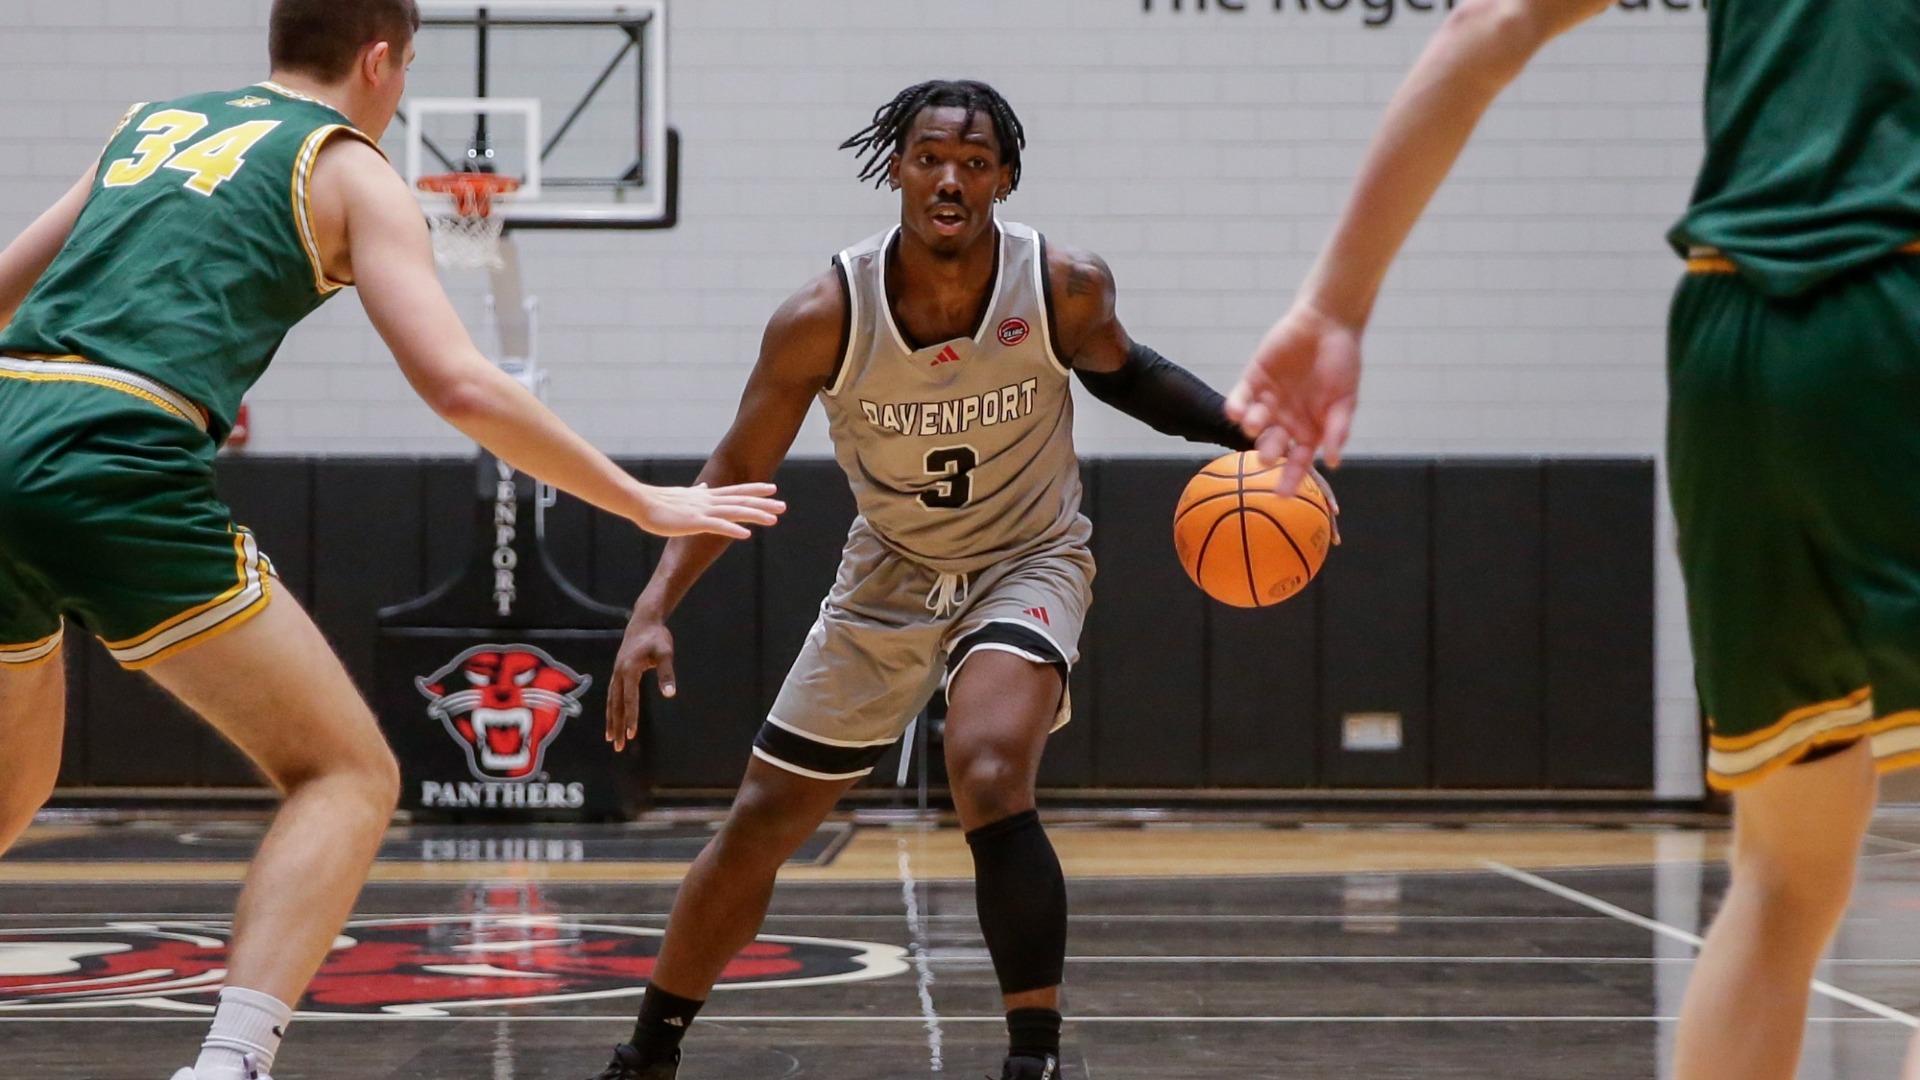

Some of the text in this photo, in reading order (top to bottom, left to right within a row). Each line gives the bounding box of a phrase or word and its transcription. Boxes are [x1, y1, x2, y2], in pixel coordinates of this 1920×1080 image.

[103, 109, 282, 197] 34
[859, 377, 1037, 436] DAVENPORT
[916, 443, 979, 511] 3
[492, 458, 517, 616] VENPORT
[421, 780, 585, 808] PANTHERS
